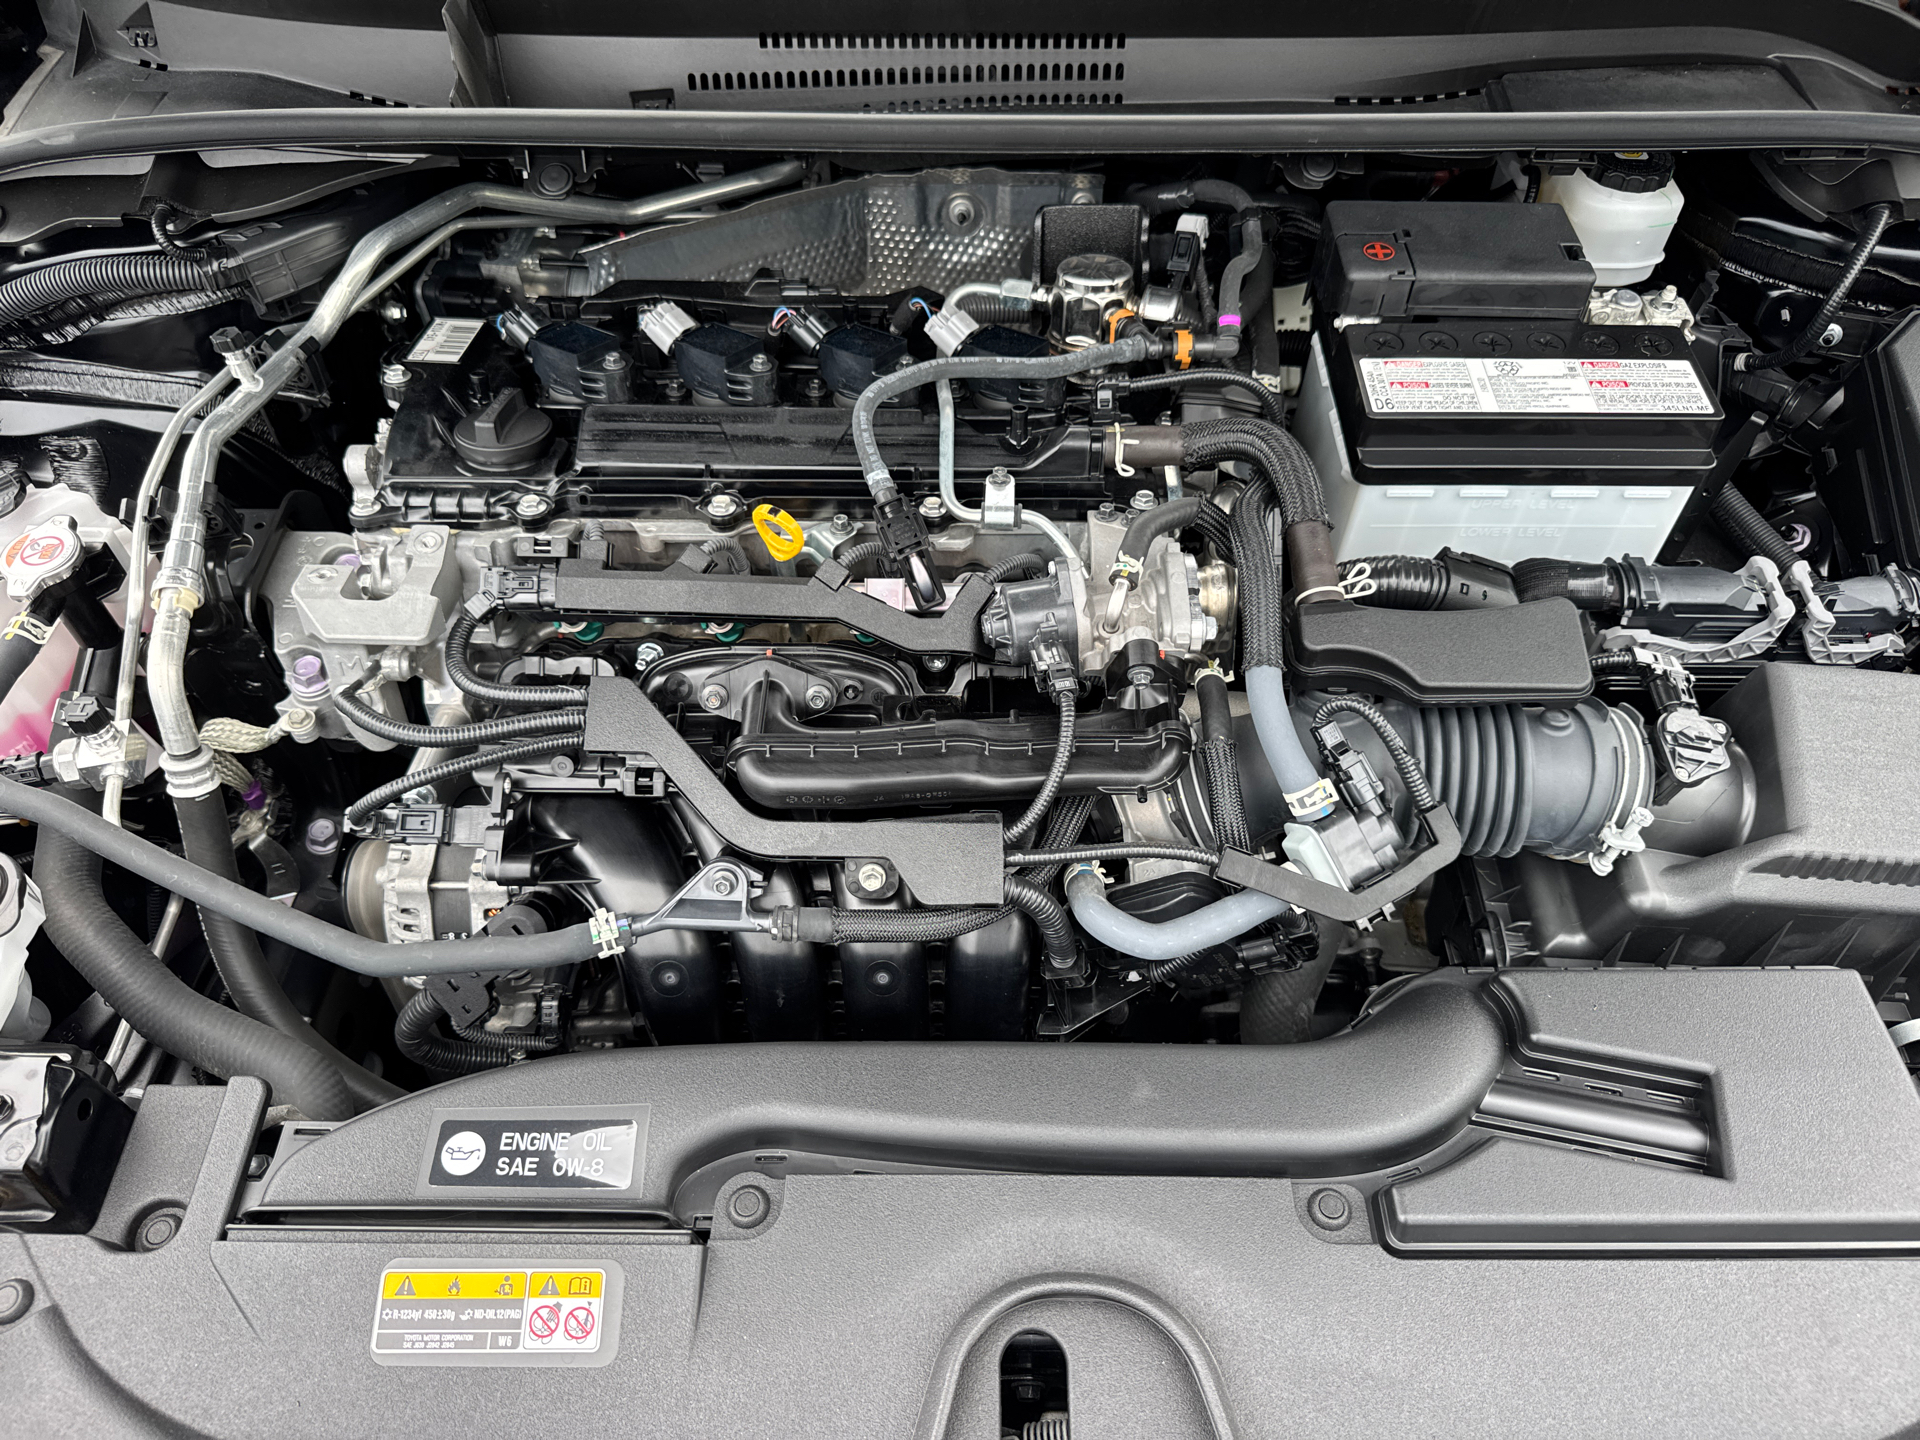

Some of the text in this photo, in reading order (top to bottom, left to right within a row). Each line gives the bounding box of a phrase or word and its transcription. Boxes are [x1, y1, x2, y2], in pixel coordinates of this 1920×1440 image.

[1374, 398, 1395, 410] D6
[1470, 500, 1575, 509] UPPER LEVEL
[1460, 528, 1560, 537] LOWER LEVEL
[499, 1132, 612, 1151] ENGINE OIL
[495, 1158, 604, 1177] SAE 0W-8
[393, 1309, 422, 1321] R-1234yf
[499, 1336, 512, 1346] W6
